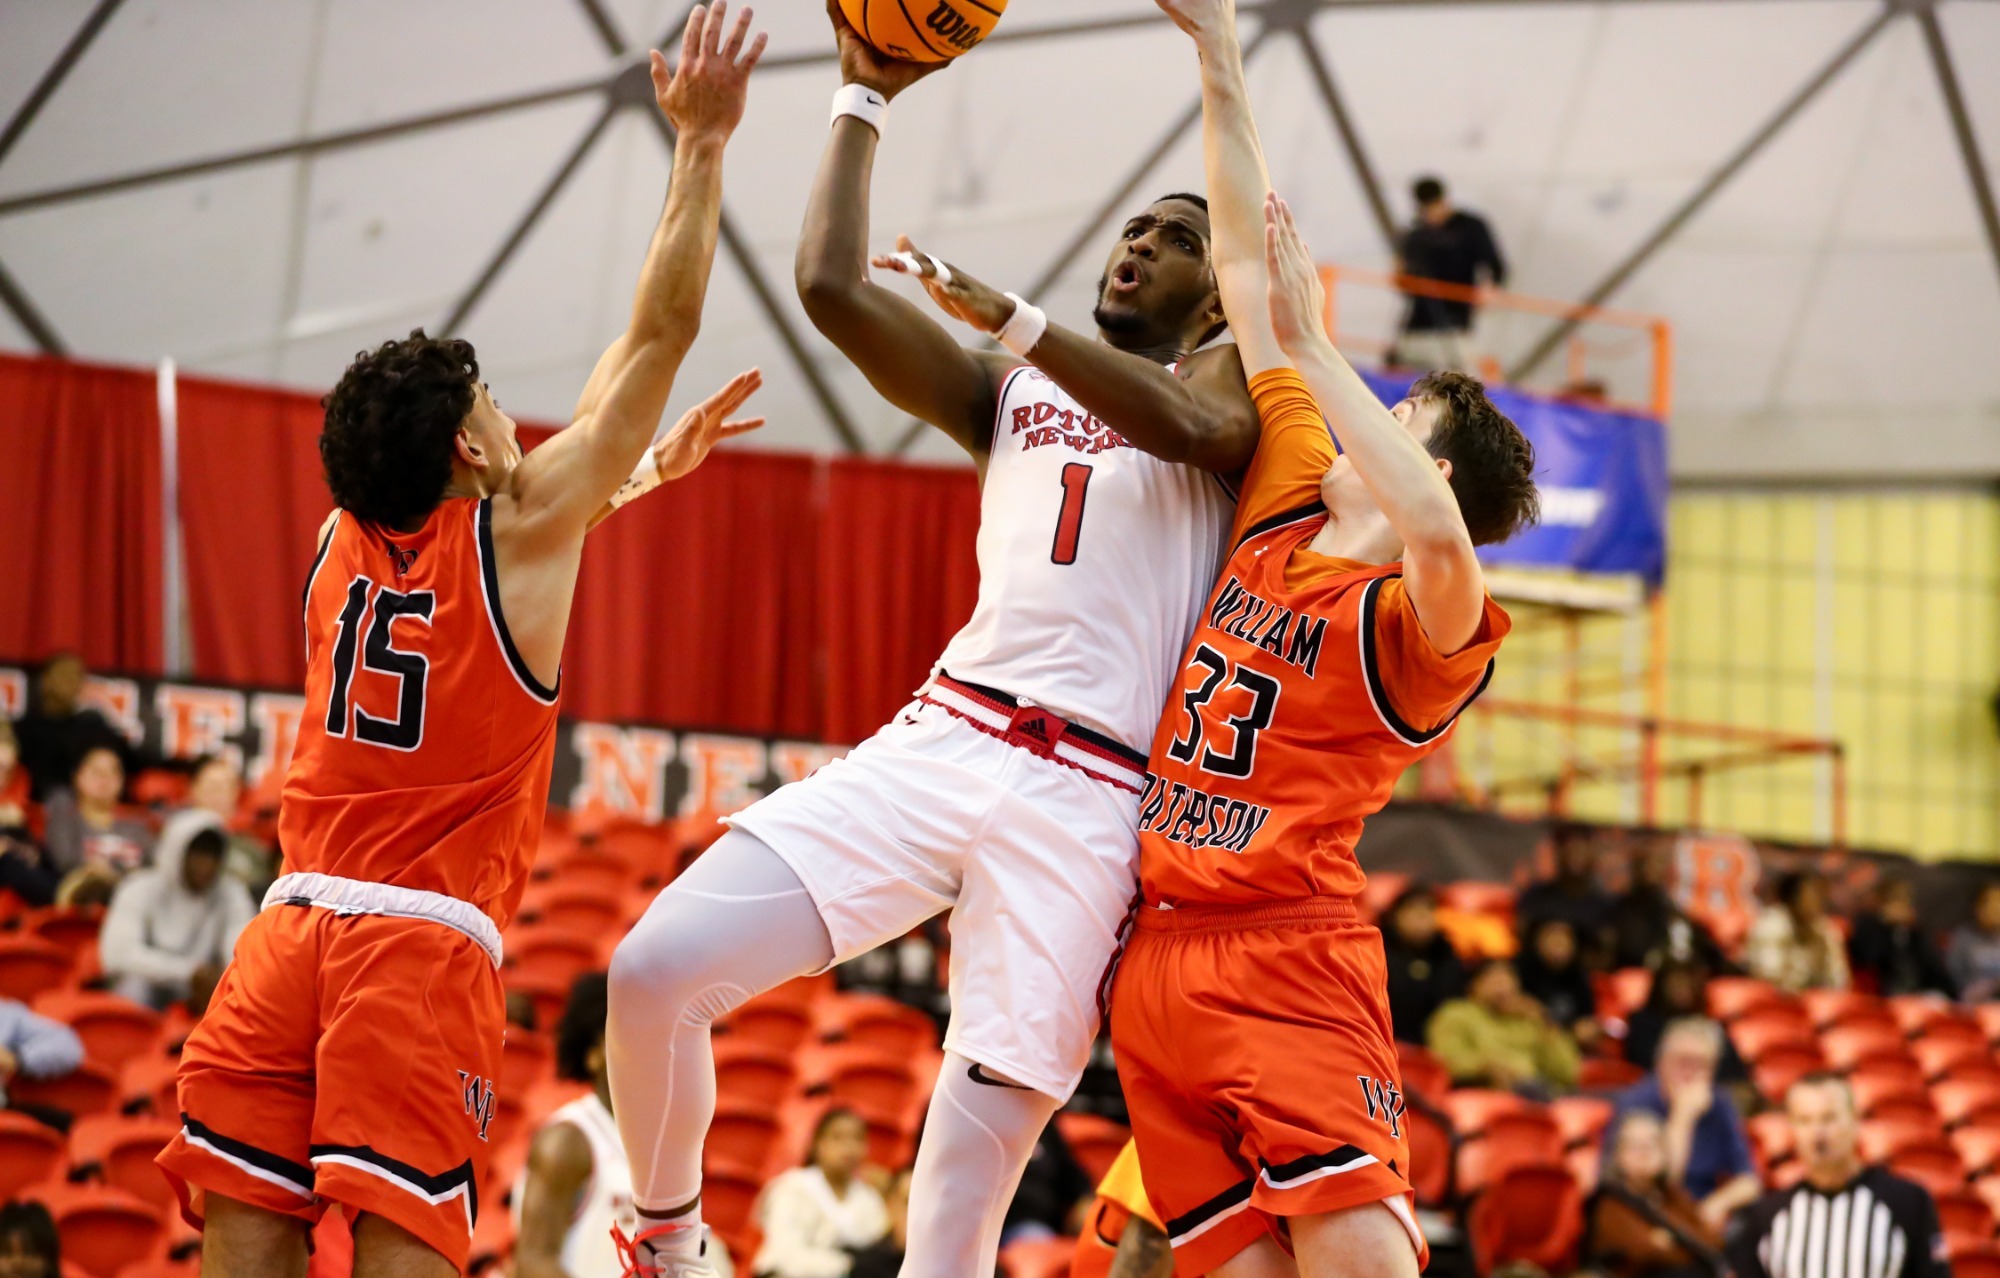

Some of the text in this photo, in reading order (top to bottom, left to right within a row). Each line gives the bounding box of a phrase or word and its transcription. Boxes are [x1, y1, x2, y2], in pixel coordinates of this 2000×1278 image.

[1011, 401, 1110, 435] RUTG
[1022, 426, 1134, 454] NEWAR
[1051, 462, 1093, 565] 1
[325, 574, 436, 752] 15
[1166, 641, 1282, 780] 33
[456, 1069, 496, 1142] WP
[1357, 1075, 1407, 1139] WP
